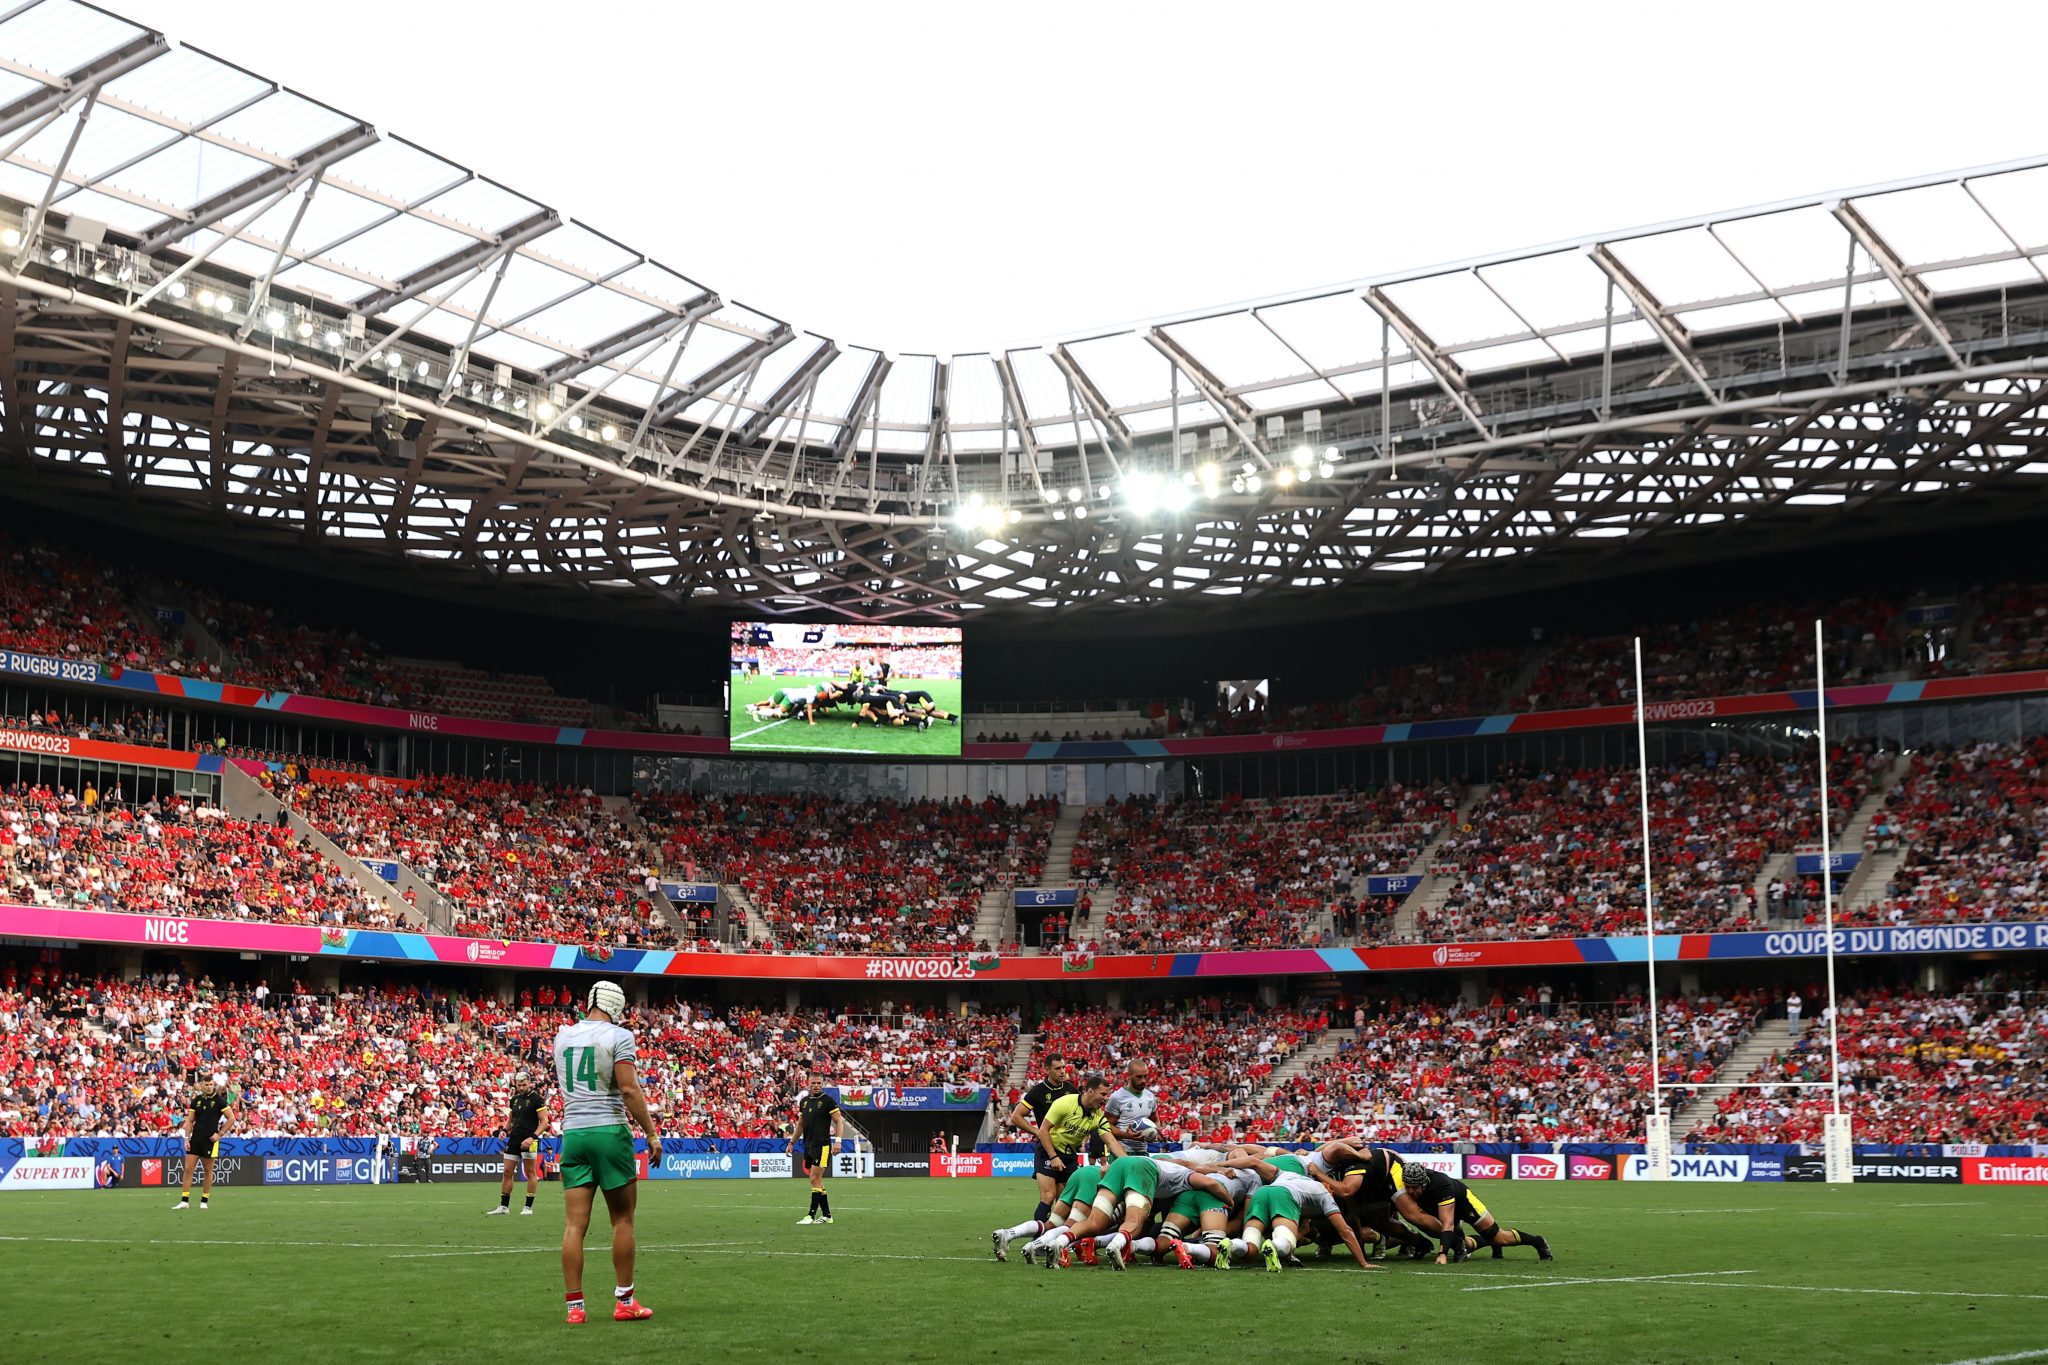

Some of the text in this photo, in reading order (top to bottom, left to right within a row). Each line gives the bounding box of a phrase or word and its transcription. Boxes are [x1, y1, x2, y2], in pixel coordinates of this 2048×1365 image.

[11, 654, 59, 676] RUGBY
[62, 662, 96, 682] 2023
[409, 713, 438, 730] NICE
[145, 918, 189, 943] NICE
[1850, 930, 1884, 952] DU
[865, 959, 976, 978] #RWC2023
[563, 1046, 598, 1092] 14
[13, 1167, 59, 1180] SUPER
[62, 1166, 90, 1179] TRY
[167, 1158, 241, 1171] LA ASION
[285, 1159, 330, 1182] GMF
[354, 1158, 390, 1180] GM
[432, 1163, 517, 1174] DEFENDE
[666, 1154, 720, 1177] Capgemini
[992, 1157, 1035, 1172] Capgemini
[1431, 1161, 1456, 1171] TRY
[1468, 1164, 1505, 1176] SNCF
[1519, 1164, 1556, 1176] SNCF
[1571, 1164, 1611, 1177] SNCF
[1636, 1159, 1738, 1177] POMAN
[1852, 1165, 1958, 1177] EFENDER
